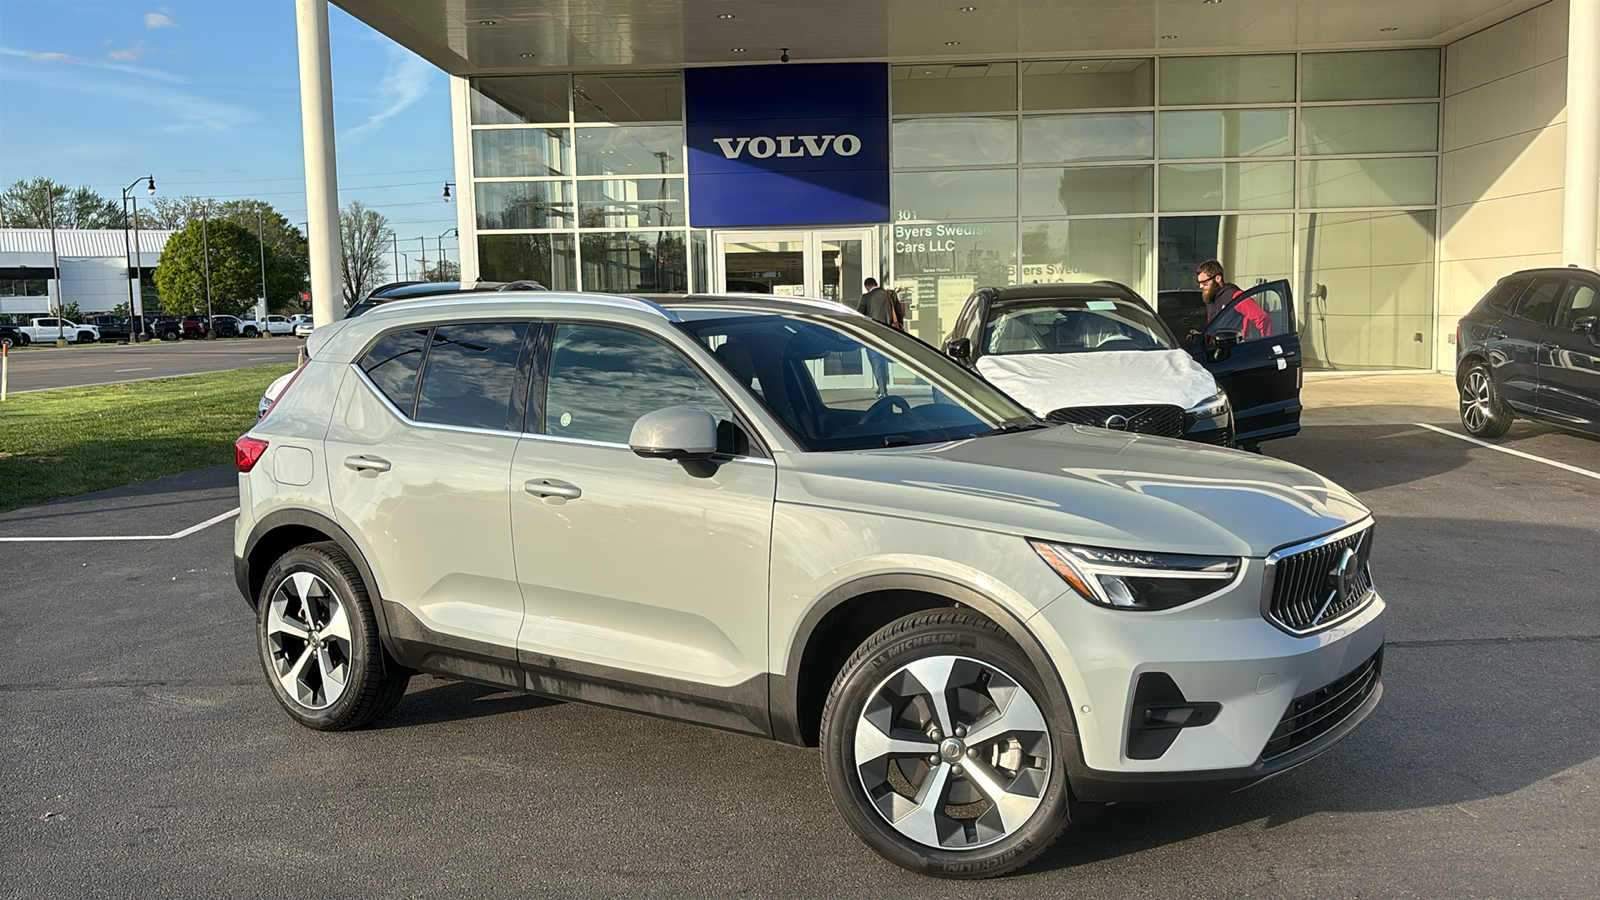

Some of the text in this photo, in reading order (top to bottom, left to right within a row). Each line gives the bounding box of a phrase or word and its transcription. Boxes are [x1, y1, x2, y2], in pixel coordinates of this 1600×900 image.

[713, 134, 862, 159] VOLVO
[896, 224, 991, 240] Byers Swedish
[896, 240, 955, 253] Cars LLC
[888, 633, 957, 658] MICHELIN
